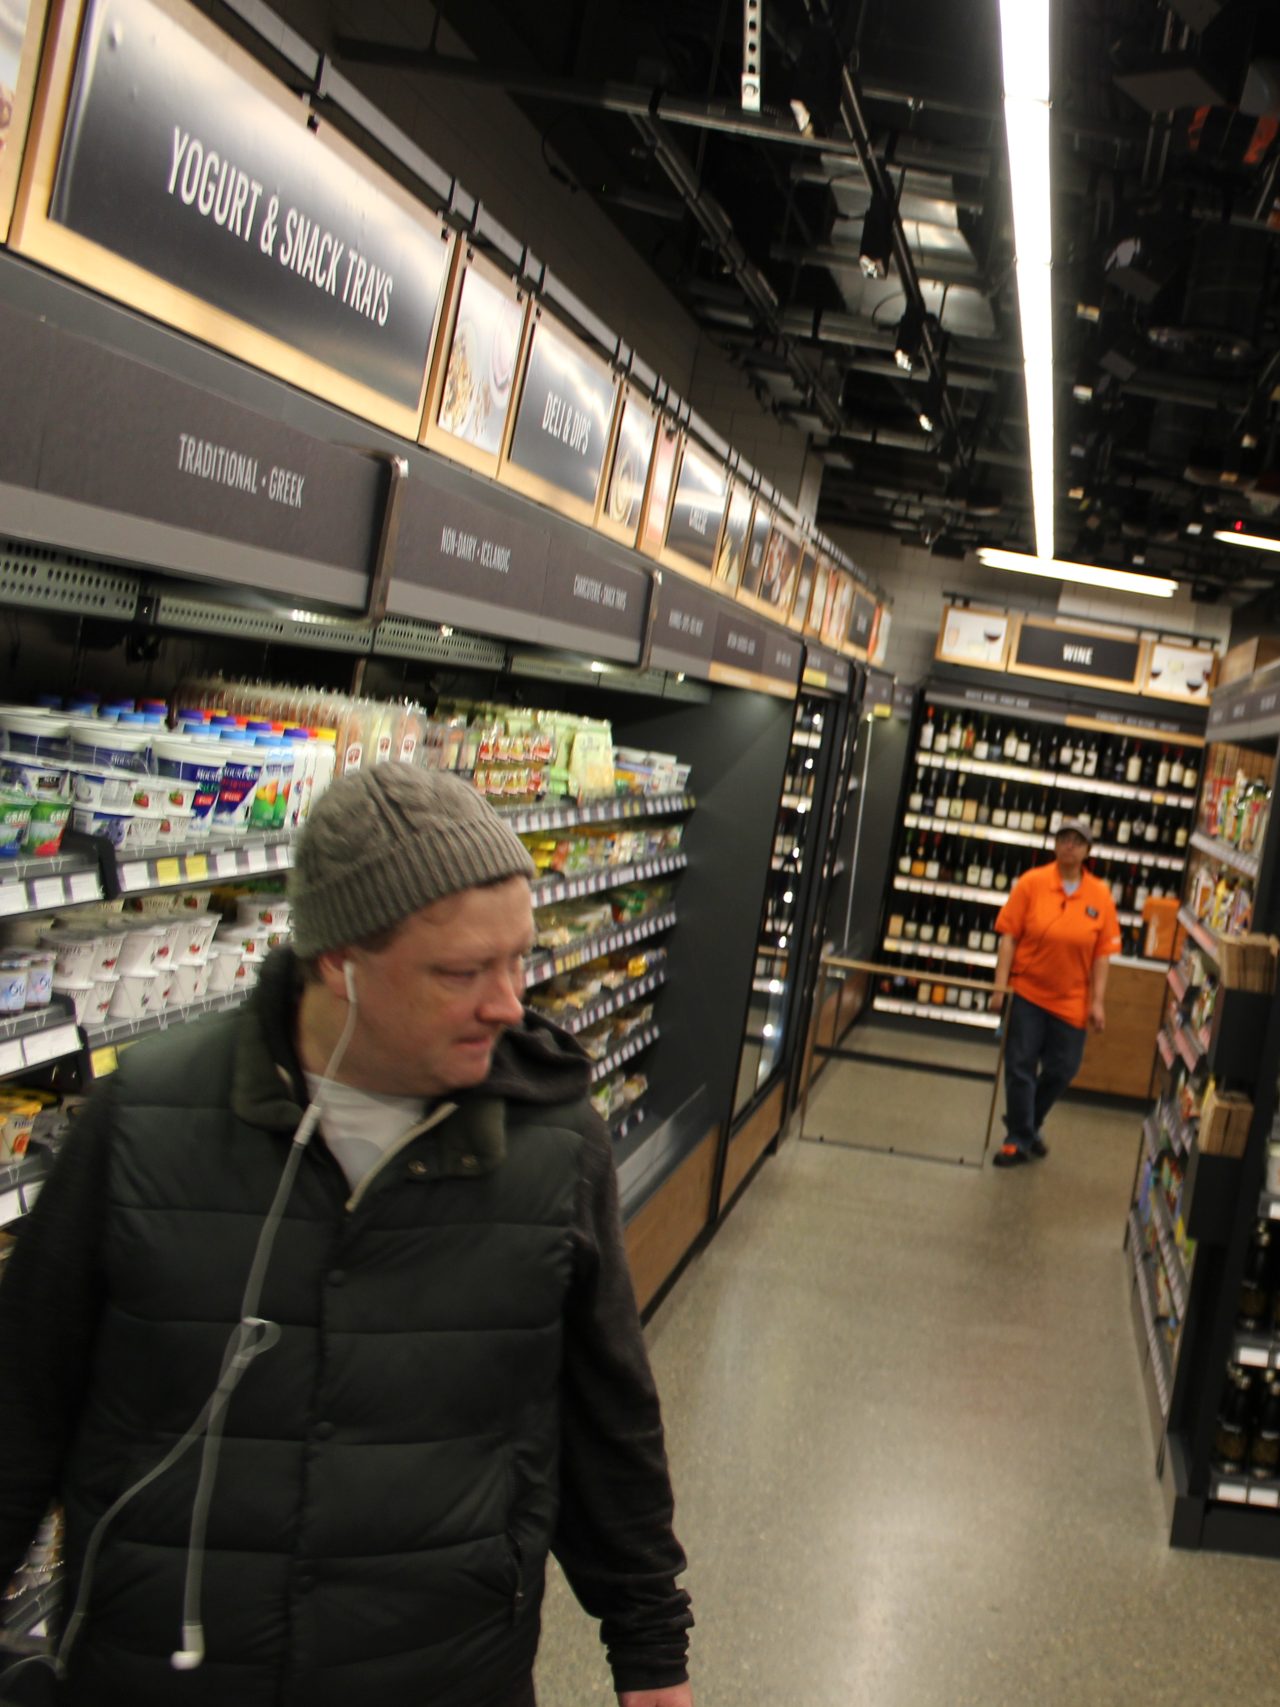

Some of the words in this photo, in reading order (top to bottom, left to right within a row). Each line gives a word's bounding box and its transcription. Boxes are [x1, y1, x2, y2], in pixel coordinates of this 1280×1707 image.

[168, 125, 263, 242] YOGURT
[260, 195, 280, 257] &
[279, 207, 345, 296] SNACK
[342, 249, 393, 327] TRAYS
[542, 390, 566, 439] DELI
[562, 405, 573, 444] &
[570, 411, 592, 456] DIPS
[178, 433, 258, 494] TRADITIONAL
[268, 466, 305, 509] GREEK
[440, 526, 477, 562] NON-DAIRY
[480, 539, 511, 574] ICELANDIC
[1062, 643, 1094, 666] WINE
